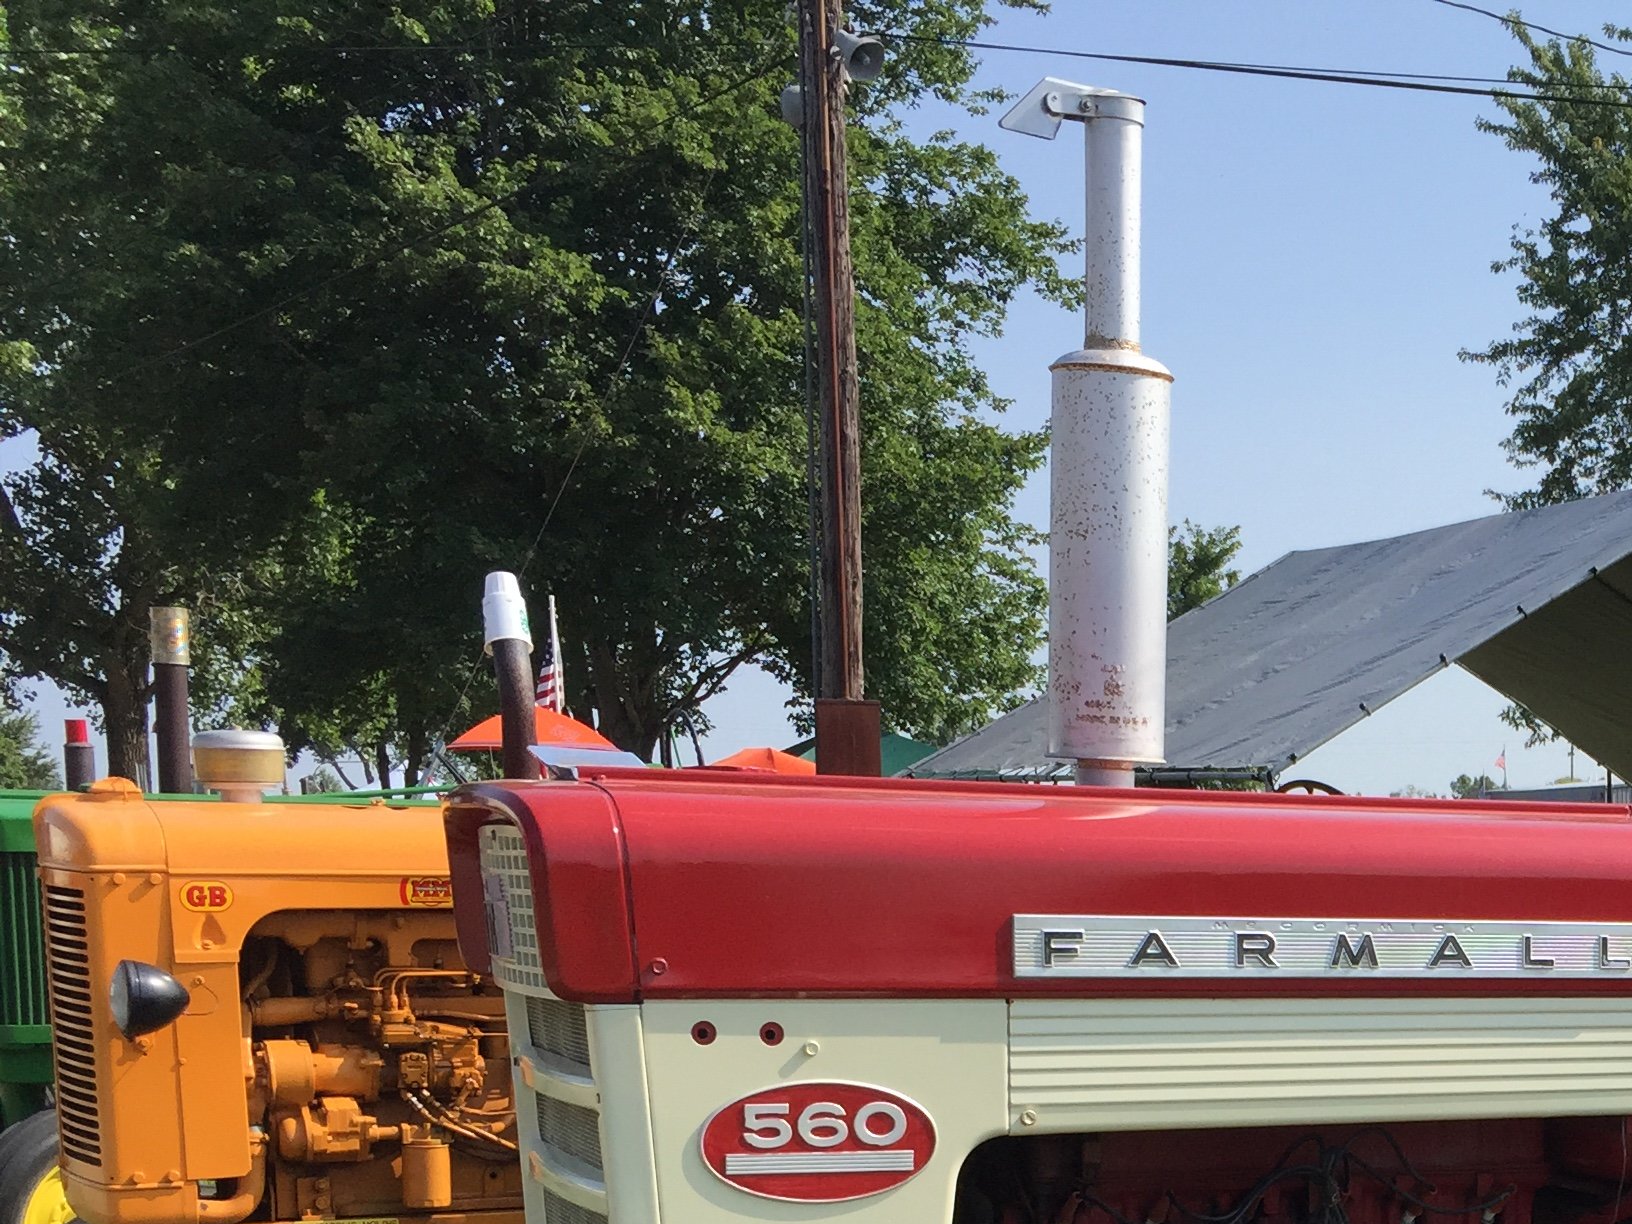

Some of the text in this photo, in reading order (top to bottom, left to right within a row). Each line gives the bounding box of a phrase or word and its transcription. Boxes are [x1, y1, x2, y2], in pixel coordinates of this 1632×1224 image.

[186, 885, 227, 907] GB
[1041, 928, 1632, 969] FARMALL
[743, 1101, 908, 1149] 560
